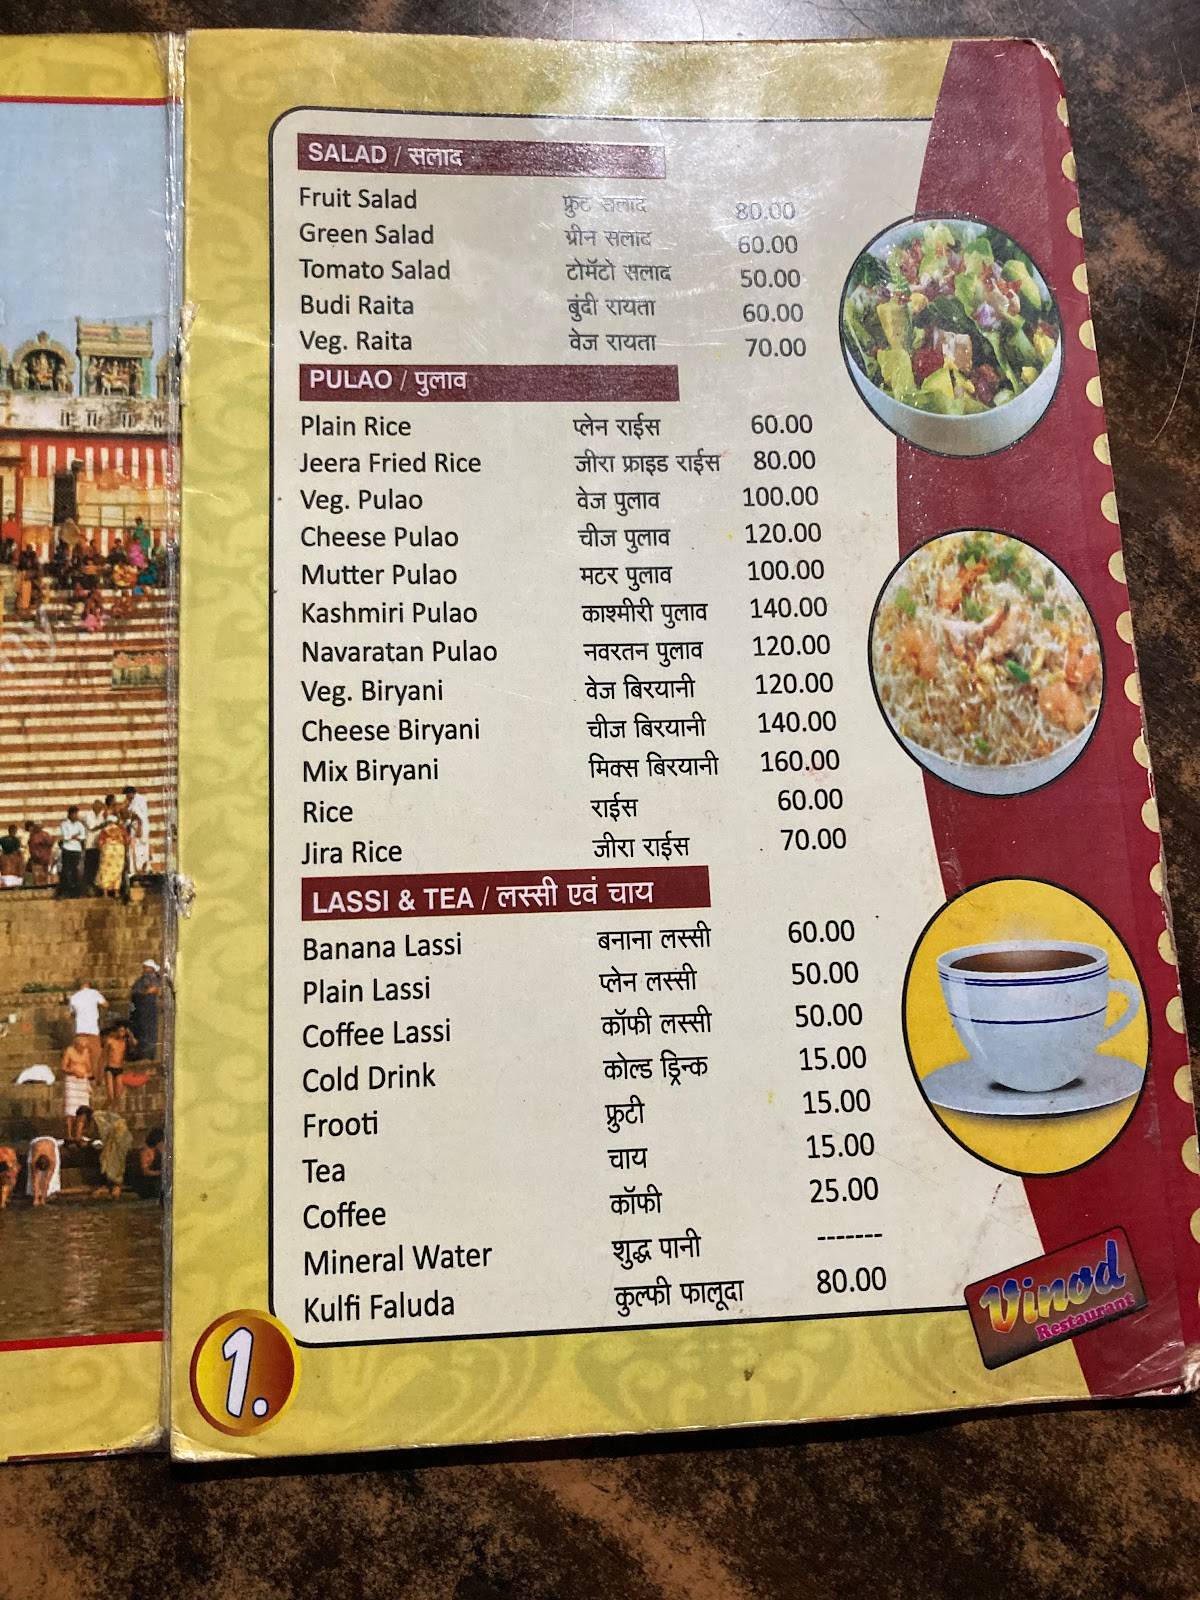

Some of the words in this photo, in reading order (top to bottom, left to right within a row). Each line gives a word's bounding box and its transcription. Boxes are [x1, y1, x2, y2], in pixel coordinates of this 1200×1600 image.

[309, 143, 386, 163] SALAD
[408, 148, 463, 166] सलाद
[300, 187, 351, 207] Fruit
[359, 189, 416, 209] Salad
[734, 202, 796, 221] 80.00
[300, 223, 367, 243] Green
[376, 224, 433, 244] Salad
[564, 224, 597, 246] ग्रीन
[603, 231, 652, 247] सलाद
[739, 235, 798, 254] 60.00
[299, 259, 384, 279] Tomato
[392, 259, 450, 279] Salad
[623, 265, 672, 281] सलाद
[741, 269, 800, 288] 50.00
[302, 294, 349, 314] Budi
[359, 296, 413, 314] Raita
[567, 292, 598, 322] बुंदी
[605, 299, 656, 316] रायता
[743, 303, 803, 322] 60.00
[300, 331, 347, 355] Veg.
[357, 331, 412, 350] Raita
[569, 328, 599, 350] वेज
[606, 335, 656, 351] रायता
[745, 338, 806, 357] 70.00
[311, 370, 392, 389] PULAO
[414, 372, 467, 396] पुलाव
[302, 415, 355, 436] Plain
[365, 416, 411, 436] Rice
[573, 413, 608, 436] प्लेन
[615, 412, 661, 440] राईस
[752, 414, 812, 434] 60.00
[300, 453, 360, 472] Jeera
[370, 452, 425, 472] Fried
[435, 453, 481, 472] Rice
[574, 449, 615, 472] जीरा
[622, 456, 669, 476] फ्राइड
[676, 448, 721, 475] राईस
[754, 450, 815, 470] 80.00
[300, 490, 349, 514] Veg.
[359, 488, 422, 509] Pulao
[576, 486, 607, 509] वेज
[614, 492, 660, 516] पुलाव
[743, 486, 818, 506] 100.00
[301, 526, 385, 547] Cheese
[395, 526, 458, 546] Pulao
[578, 523, 617, 547] चीज
[624, 529, 671, 553] पुलाव
[746, 523, 821, 543] 120.00
[303, 565, 384, 584] Mutter
[393, 563, 457, 584] Pulao
[580, 568, 618, 585] मटर
[625, 567, 672, 591] पुलाव
[748, 560, 824, 580] 100.00
[303, 601, 403, 623] Kashmiri
[413, 601, 477, 623] Pulao
[581, 597, 654, 623] काश्मीरी
[661, 604, 708, 629] पुलाव
[751, 597, 827, 618] 140.00
[303, 642, 423, 662] Navaratan
[433, 640, 497, 661] Pulao
[583, 643, 649, 661] नवरतन
[656, 642, 703, 667] पुलाव
[753, 634, 830, 656] 120.00
[301, 681, 352, 707] Veg.
[362, 680, 442, 706] Biryani
[585, 675, 616, 699] वेज
[623, 673, 695, 699] बिरयानी
[756, 672, 833, 694] 120.00
[302, 719, 389, 742] Cheese
[399, 718, 479, 745] Biryani
[587, 713, 627, 738] चीज
[634, 711, 706, 738] बिरयानी
[758, 711, 836, 733] 140.00
[304, 760, 348, 782] Mix
[357, 758, 438, 786] Biryani
[588, 753, 639, 778] मिक्स
[646, 750, 719, 776] बिरयानी
[761, 750, 839, 772] 160.00
[304, 801, 353, 823] Rice
[590, 792, 638, 822] राईस
[778, 789, 843, 811] 60.00
[592, 832, 635, 858] जीरा
[642, 830, 690, 860] राईस
[781, 828, 846, 850] 70.00
[302, 842, 342, 864] Jira
[353, 840, 402, 863] Rice
[314, 890, 388, 913] LASSI
[399, 890, 415, 911] &
[423, 888, 474, 909] TEA
[496, 876, 558, 907] लस्सी
[567, 876, 598, 905] एवं
[607, 882, 654, 903] चाय
[597, 930, 652, 950] बनाना
[659, 920, 711, 948] लस्सी
[789, 920, 854, 943] 60.00
[304, 938, 395, 960] Banana
[406, 932, 461, 956] Lassi
[599, 966, 637, 992] प्लेन
[645, 963, 697, 991] लस्सी
[792, 961, 858, 985] 50.00
[304, 979, 363, 1004] Plain
[374, 976, 429, 1001] Lassi
[601, 1007, 652, 1036] कॉफी
[659, 1005, 712, 1034] लस्सी
[796, 1003, 862, 1027] 50.00
[303, 1021, 383, 1048] Coffee
[394, 1018, 450, 1044] Lassi
[603, 1052, 653, 1080] कोल्ड
[800, 1046, 866, 1070] 15.00
[303, 1065, 358, 1092] Cold
[369, 1062, 435, 1089] Drink
[803, 1089, 870, 1114] 15.00
[304, 1110, 377, 1138] Frooti
[605, 1095, 645, 1133] फ्रुटी
[807, 1133, 874, 1158] 15.00
[607, 1148, 648, 1169] चाय
[302, 1159, 345, 1183] Tea
[609, 1184, 662, 1215] कॉफी
[810, 1177, 878, 1203] 25.00
[304, 1201, 385, 1229] Coffee
[305, 1245, 403, 1276] Mineral
[412, 1244, 492, 1269] Water
[612, 1239, 652, 1270] शुद्ध
[659, 1228, 701, 1258] पानी
[817, 1267, 886, 1294] 80.00
[979, 1239, 1126, 1333] Vinod
[305, 1294, 359, 1323] Kulfi
[371, 1290, 454, 1319] Faluda
[614, 1276, 672, 1317] कुल्फी
[680, 1280, 744, 1311] फालूदा
[1035, 1292, 1135, 1341] Restaurant
